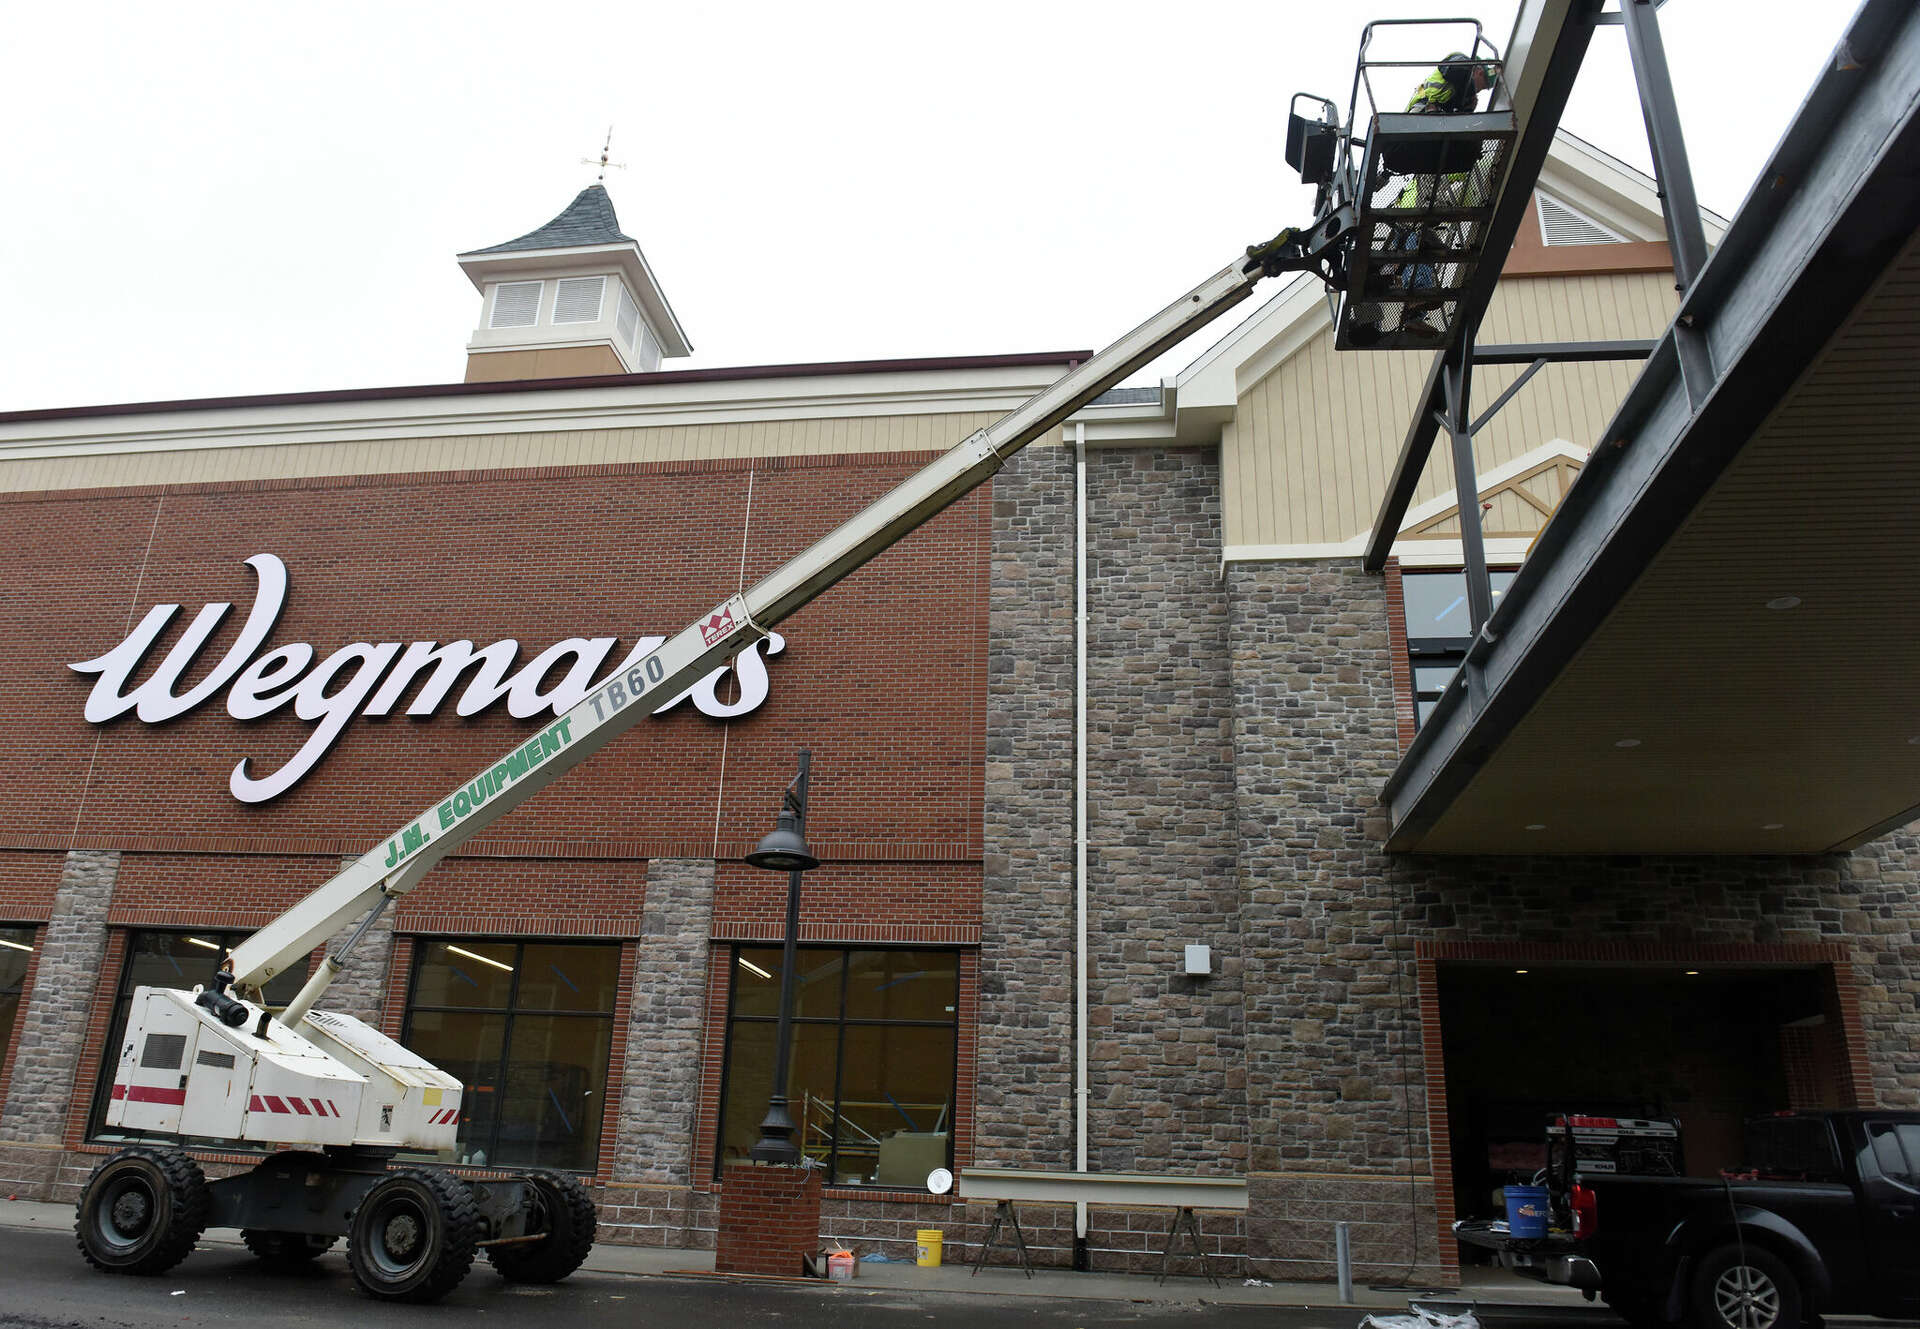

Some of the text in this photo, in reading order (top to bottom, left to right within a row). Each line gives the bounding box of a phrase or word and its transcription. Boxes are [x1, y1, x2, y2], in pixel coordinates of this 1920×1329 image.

[67, 552, 786, 805] Wegmas
[705, 622, 734, 644] TEREX
[588, 654, 665, 722] TB60
[437, 716, 572, 831] EQUIPMENT
